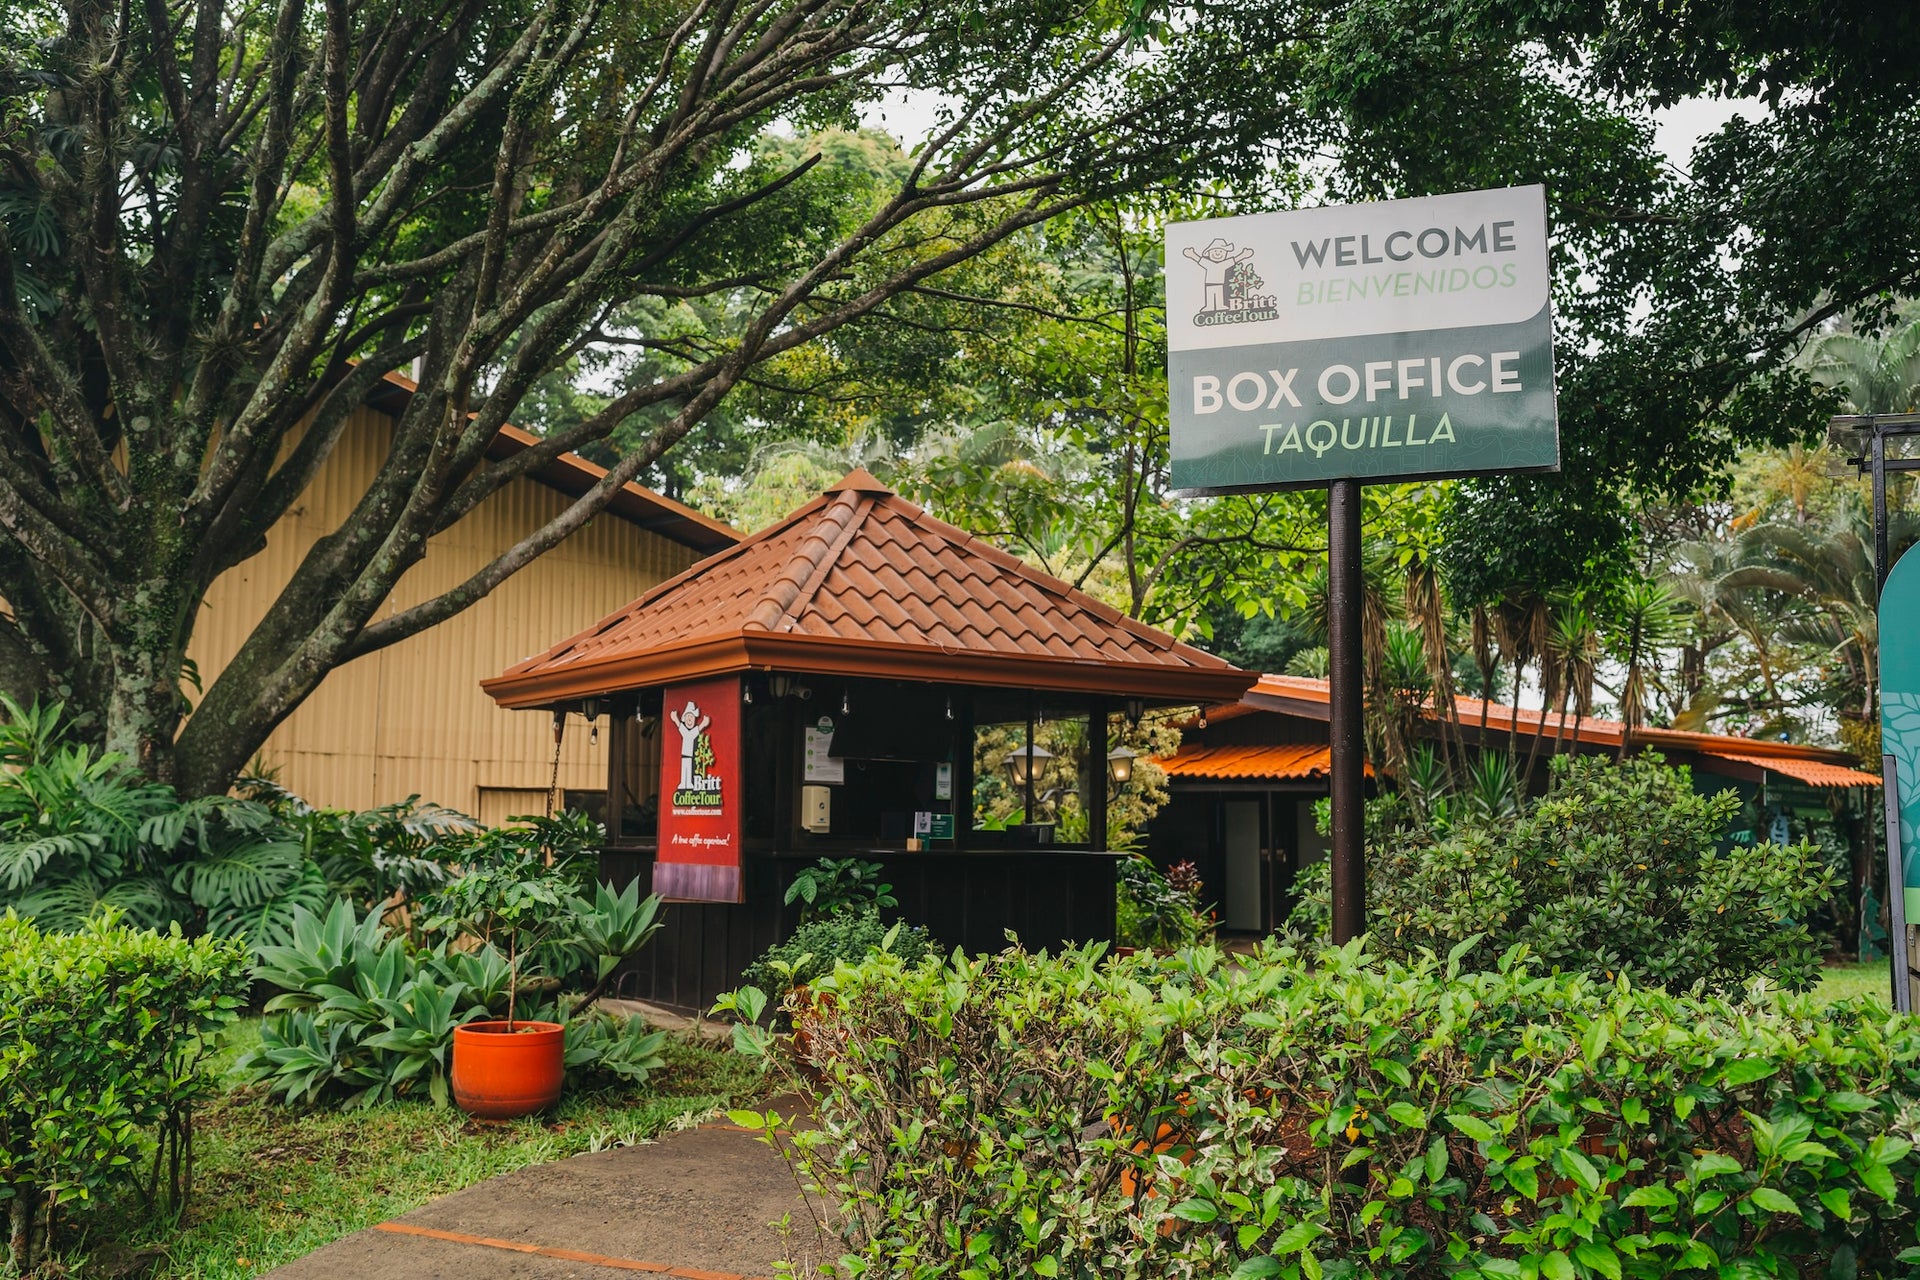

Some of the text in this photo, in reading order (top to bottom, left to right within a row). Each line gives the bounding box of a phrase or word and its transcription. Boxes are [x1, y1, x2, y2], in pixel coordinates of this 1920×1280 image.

[1290, 220, 1517, 270] WELCOME
[1229, 295, 1276, 311] Britt
[1296, 263, 1517, 307] BIENVENIDOS
[1193, 351, 1523, 414] BOX OFFICE
[1258, 412, 1457, 458] TAQUILLA
[693, 774, 721, 791] Britt
